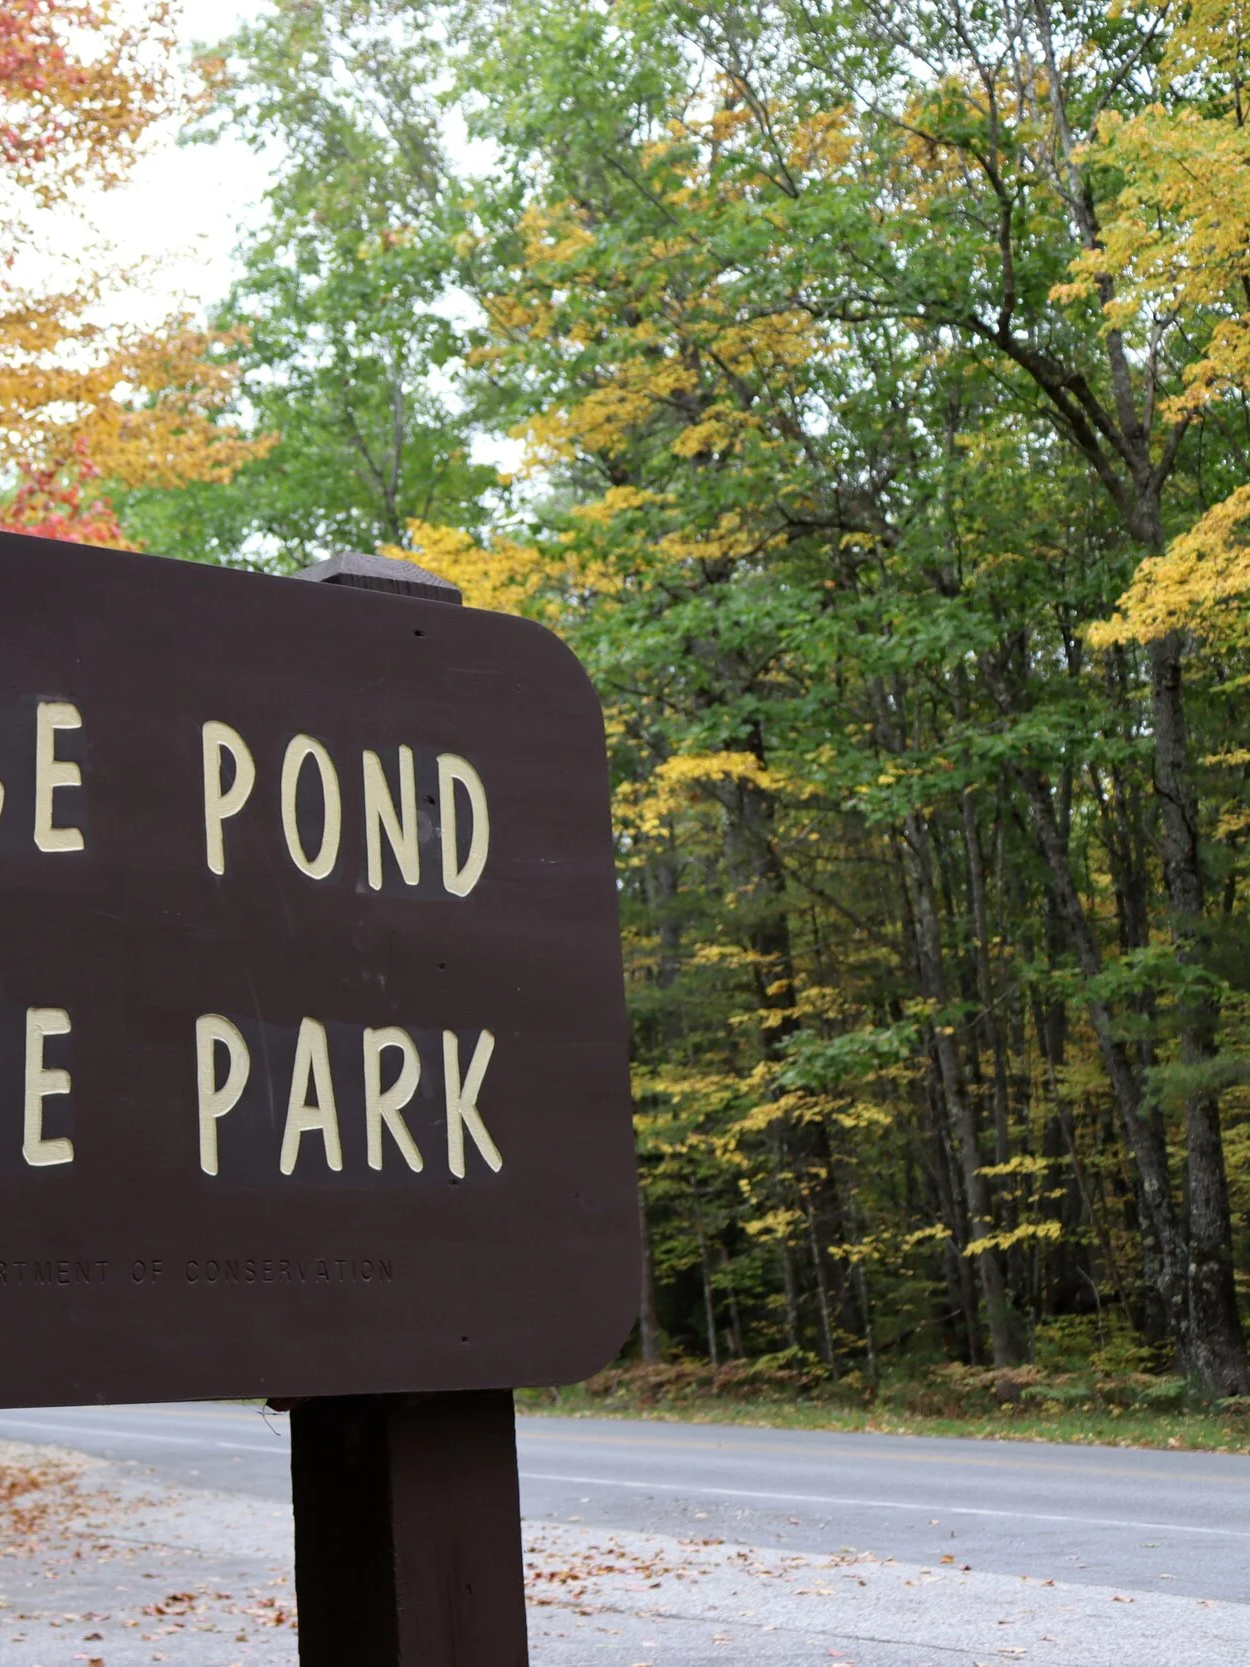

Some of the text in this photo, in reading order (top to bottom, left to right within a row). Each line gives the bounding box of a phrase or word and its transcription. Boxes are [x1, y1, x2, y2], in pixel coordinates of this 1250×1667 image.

[200, 719, 491, 899] POND
[194, 1015, 504, 1180] PARK
[131, 1259, 163, 1284] OF
[184, 1259, 394, 1284] CONSERVATION
